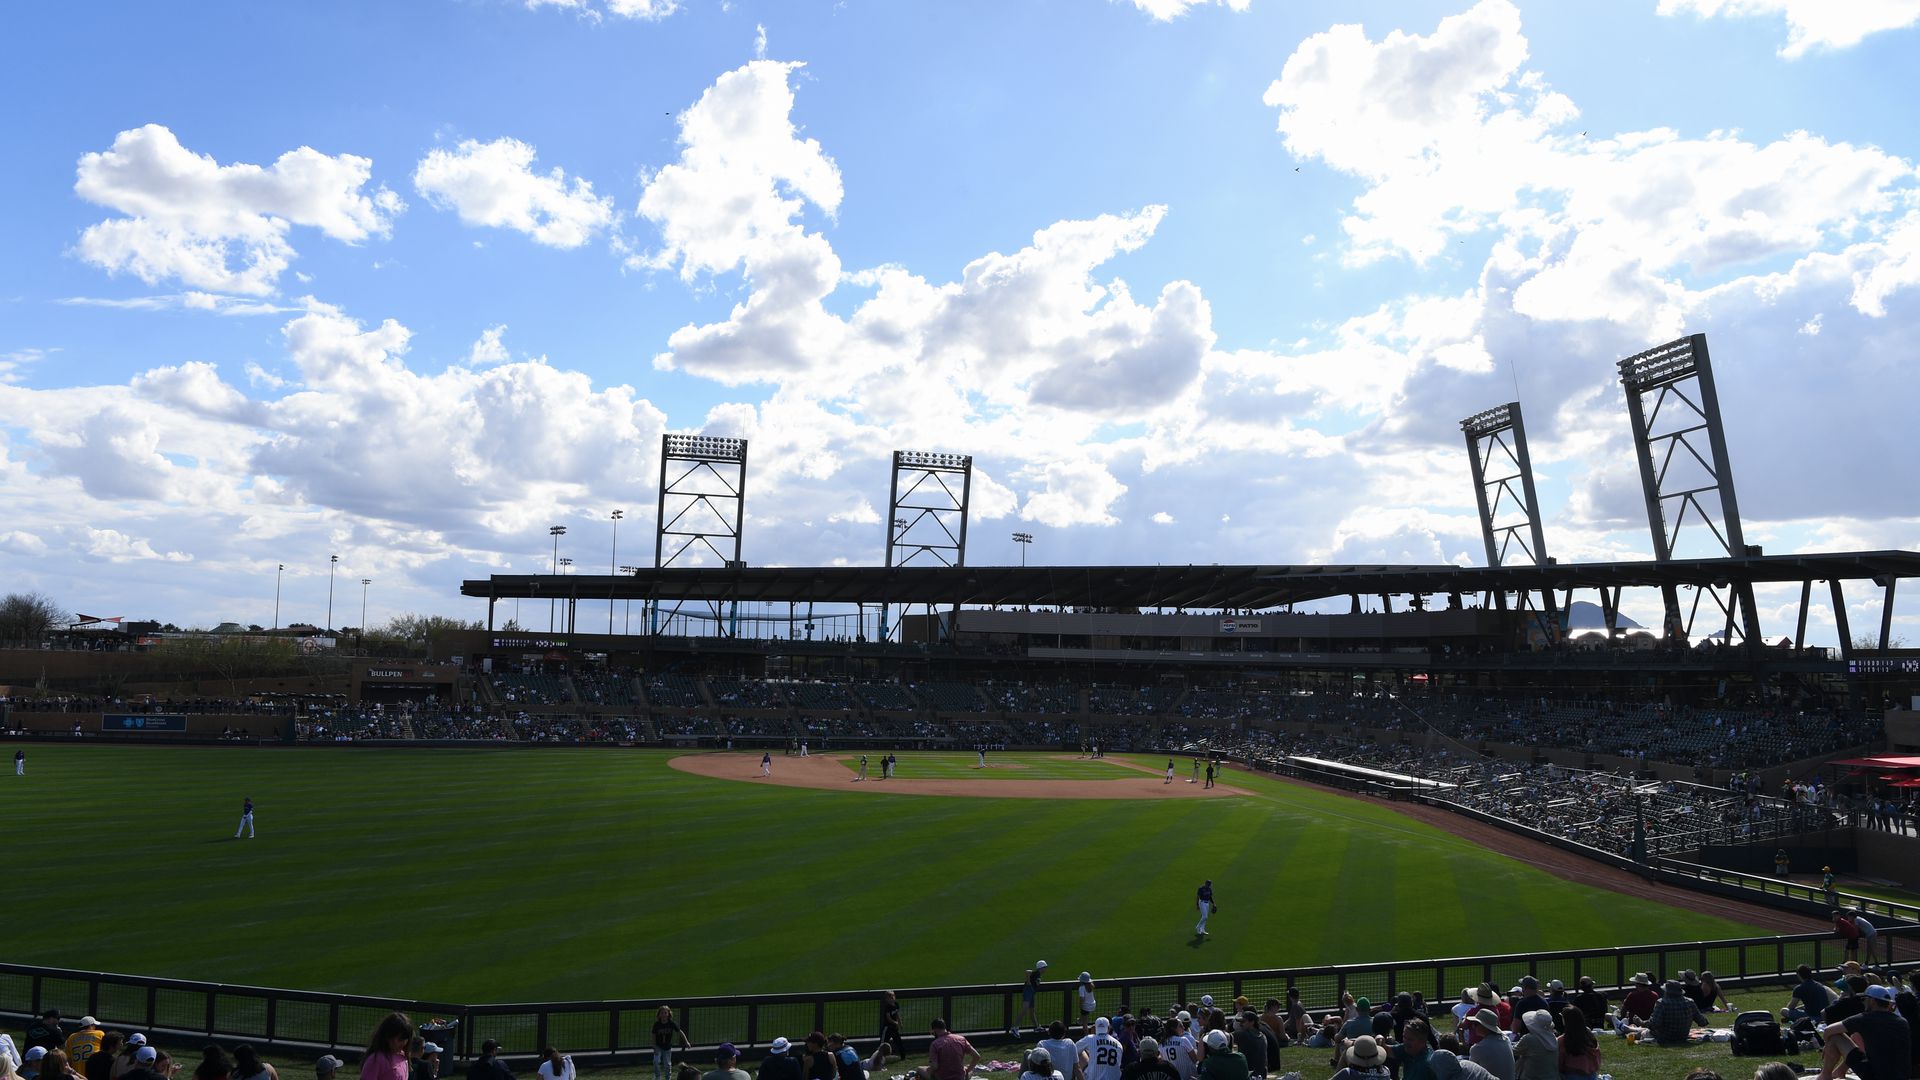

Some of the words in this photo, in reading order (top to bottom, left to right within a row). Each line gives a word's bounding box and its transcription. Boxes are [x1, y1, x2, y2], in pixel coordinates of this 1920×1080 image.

[1096, 1038, 1118, 1049] ARENADO
[72, 1043, 93, 1062] 52
[1096, 1047, 1117, 1066] 28
[1166, 1047, 1177, 1061] 19
